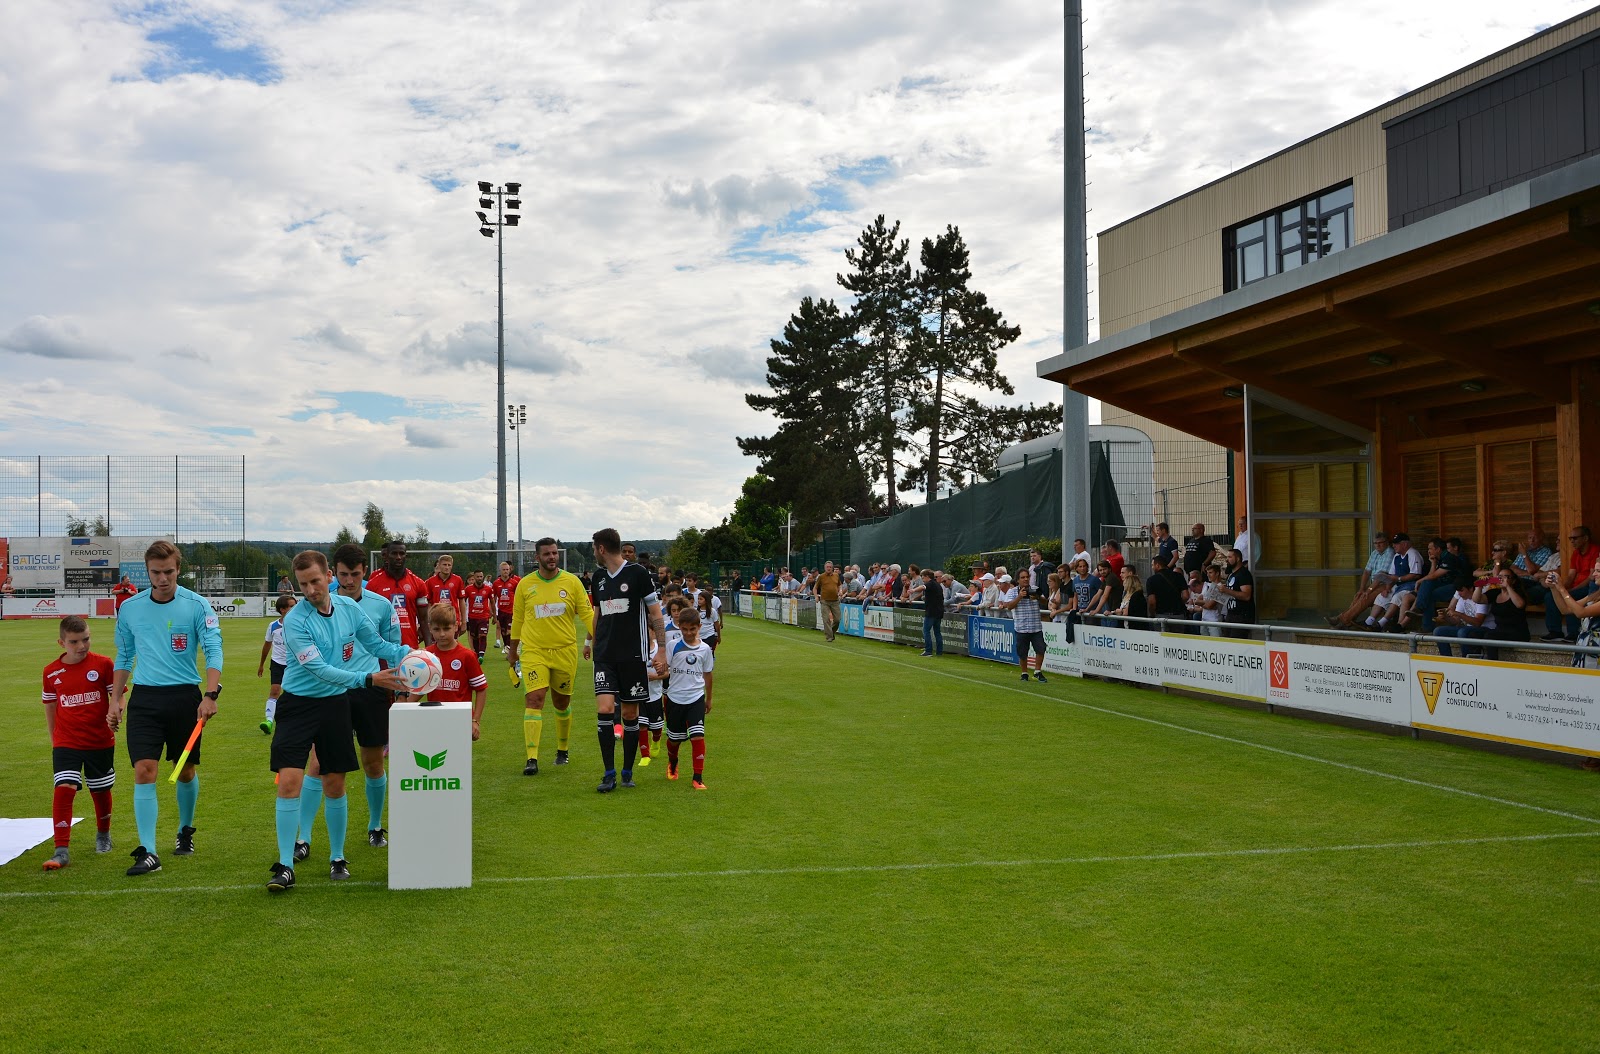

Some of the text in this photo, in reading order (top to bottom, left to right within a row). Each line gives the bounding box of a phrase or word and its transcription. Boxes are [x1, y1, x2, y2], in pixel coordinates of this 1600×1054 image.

[121, 550, 146, 558] DOHEE
[1045, 632, 1058, 643] Sport
[1082, 632, 1159, 654] Linster Buropolis
[1045, 645, 1070, 656] Construct
[1163, 647, 1263, 670] IMMOBILIEN GUY FLENER
[1293, 662, 1405, 681] COMPAGNIE GENERALE DE CONSTRUCTION
[1363, 683, 1392, 693] HESPERANGE
[1446, 679, 1478, 697] tracol
[1446, 697, 1487, 710] CONSTRUCTION
[1567, 693, 1594, 704] Sandweiler
[1570, 720, 1583, 729] +352
[1584, 722, 1592, 731] 35
[400, 775, 461, 791] erima
